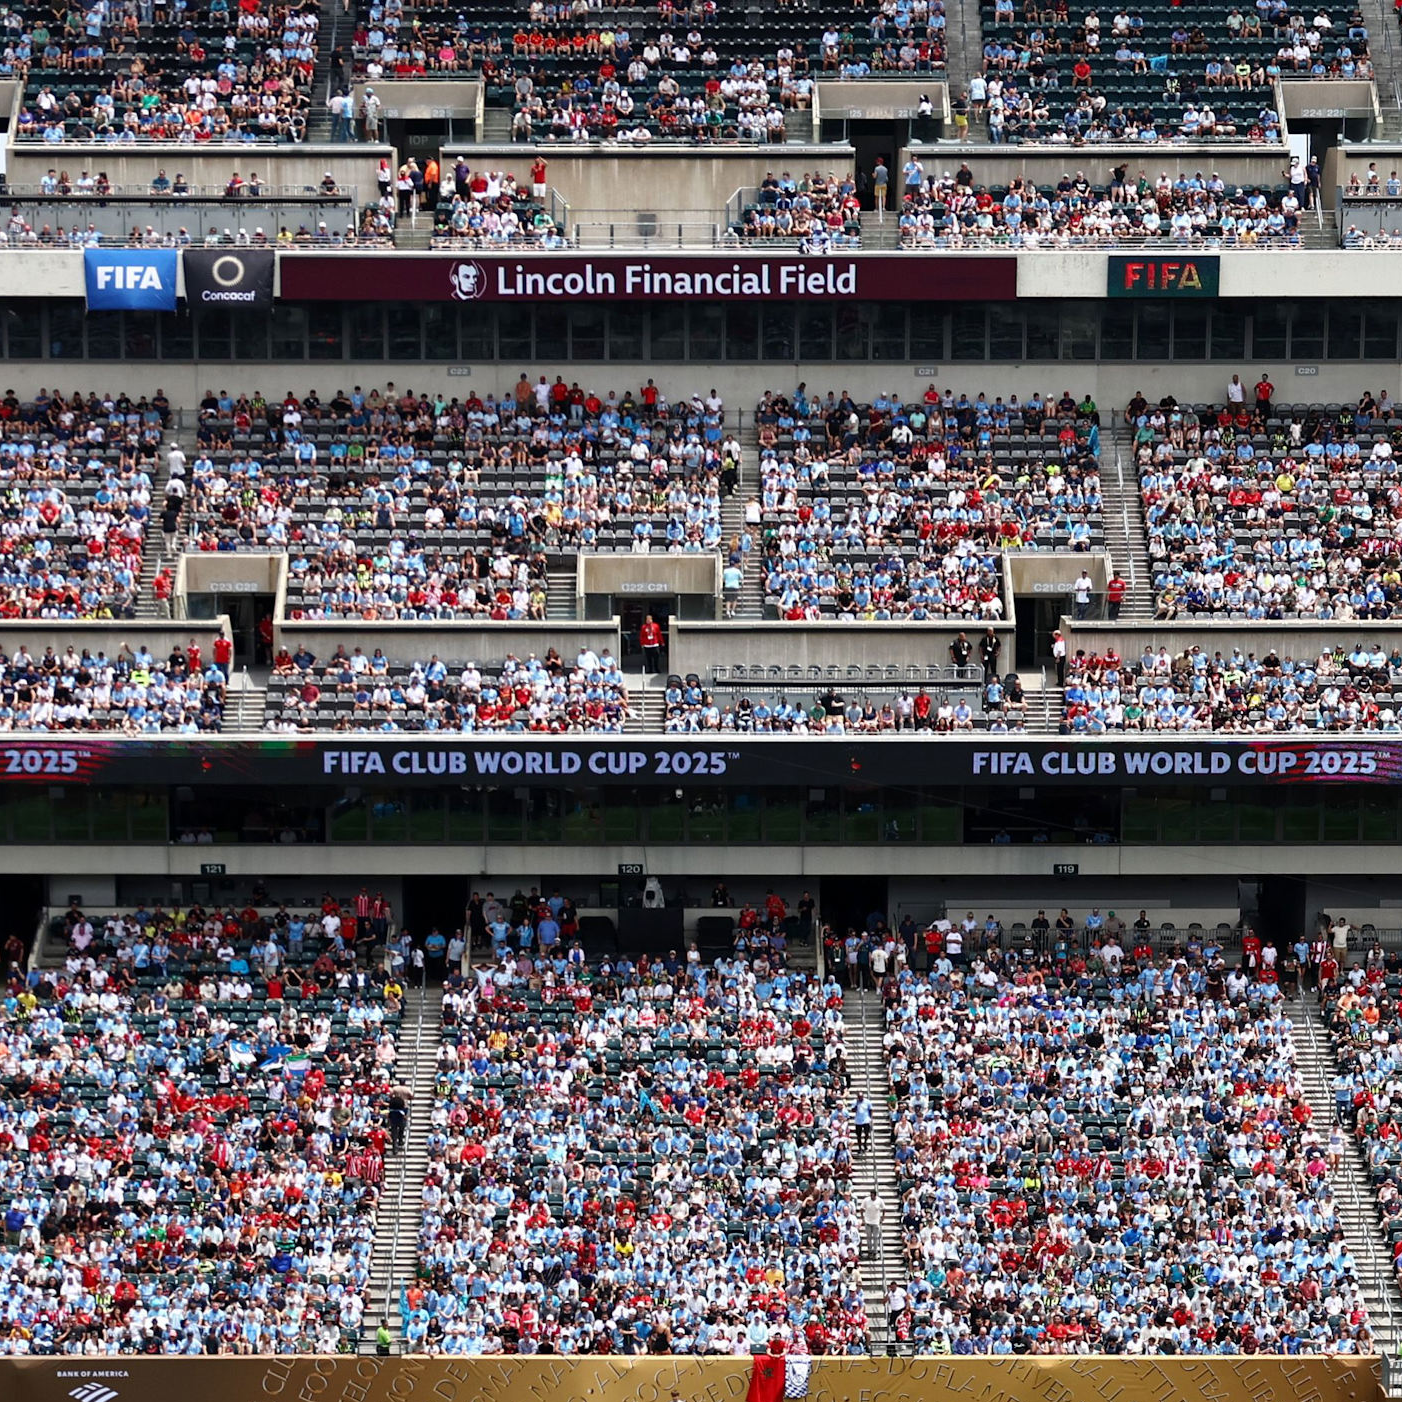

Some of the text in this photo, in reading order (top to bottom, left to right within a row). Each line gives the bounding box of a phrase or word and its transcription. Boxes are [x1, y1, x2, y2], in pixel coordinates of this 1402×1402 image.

[97, 266, 163, 290] FIFA
[498, 264, 856, 295] Lincoln Financial Field
[1125, 263, 1203, 290] FIFA
[201, 290, 256, 302] Concacaf
[647, 582, 668, 592] C21
[324, 752, 386, 774] FIFA
[393, 752, 466, 774] CLUB
[475, 751, 581, 774] WORLD
[589, 752, 647, 774] CUP
[973, 752, 1035, 774] FIFA
[1042, 752, 1116, 775] CLUB
[1124, 752, 1231, 775] WORLD
[1238, 752, 1297, 774] CUP
[204, 864, 223, 874] 121
[620, 864, 641, 874] 120
[1057, 864, 1075, 874] 119
[56, 1370, 130, 1378] BANK OF AMERICA
